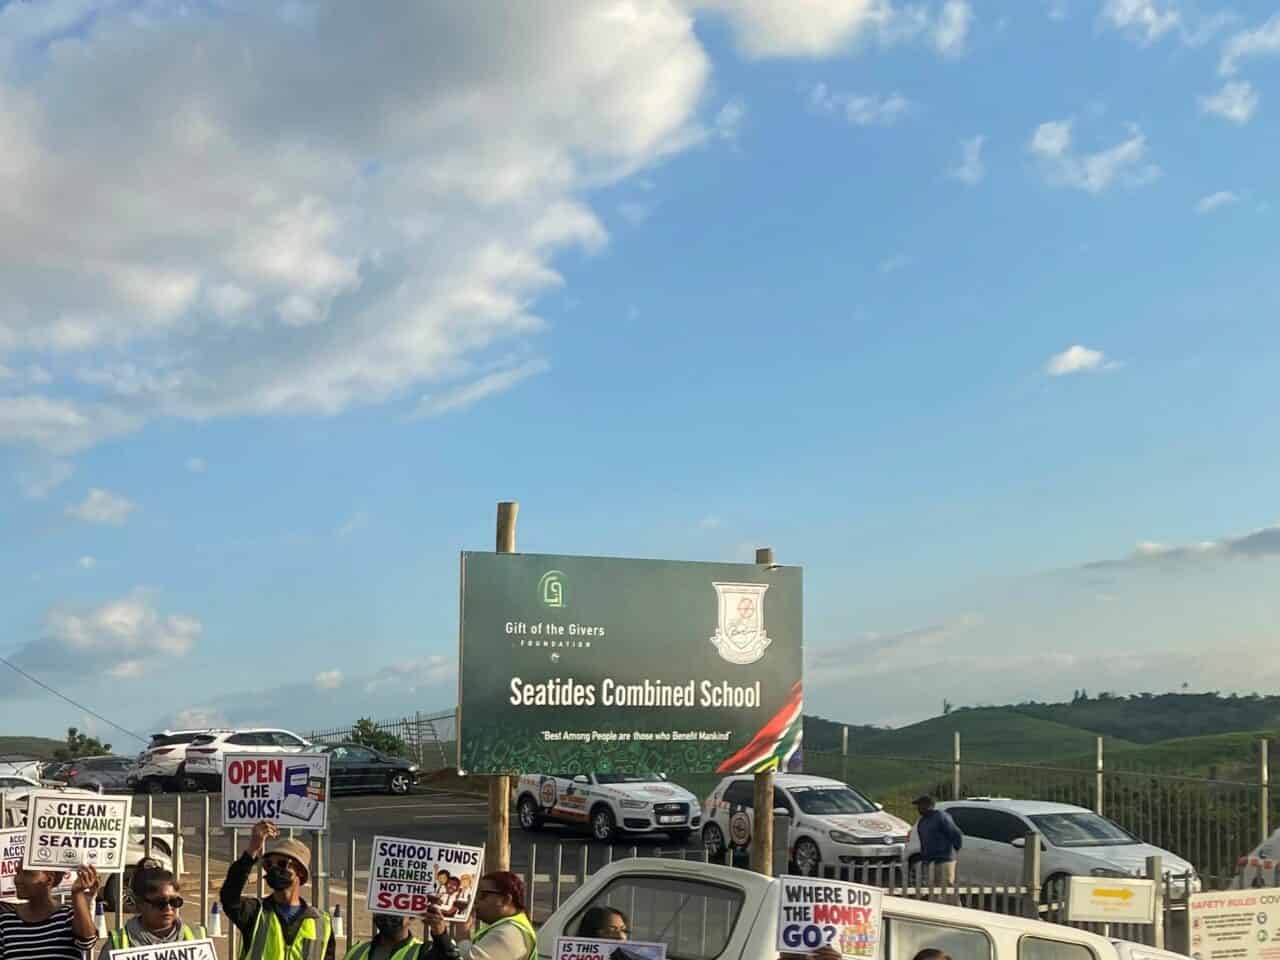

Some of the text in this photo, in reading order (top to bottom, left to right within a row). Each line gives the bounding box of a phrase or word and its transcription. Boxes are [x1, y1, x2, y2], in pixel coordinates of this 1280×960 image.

[505, 622, 605, 637] Gift of the Givers
[510, 677, 761, 708] Seatides Combined School
[228, 759, 283, 784] OPEN
[240, 784, 269, 798] THE
[57, 803, 106, 817] CLEAN
[228, 799, 281, 819] BOOKS!
[38, 816, 122, 831] GOVERNANCE
[38, 835, 117, 848] SEATIDES
[379, 842, 478, 865] SCHOOL FUNDS
[383, 858, 427, 870] ARE FOR
[377, 867, 433, 881] LEARNERS
[379, 883, 427, 894] NOT THE
[785, 885, 872, 905] WHERE DID
[377, 892, 427, 911] SGB
[783, 904, 873, 925] THE MONEY
[782, 924, 837, 948] GO?
[562, 943, 600, 953] IS THIS
